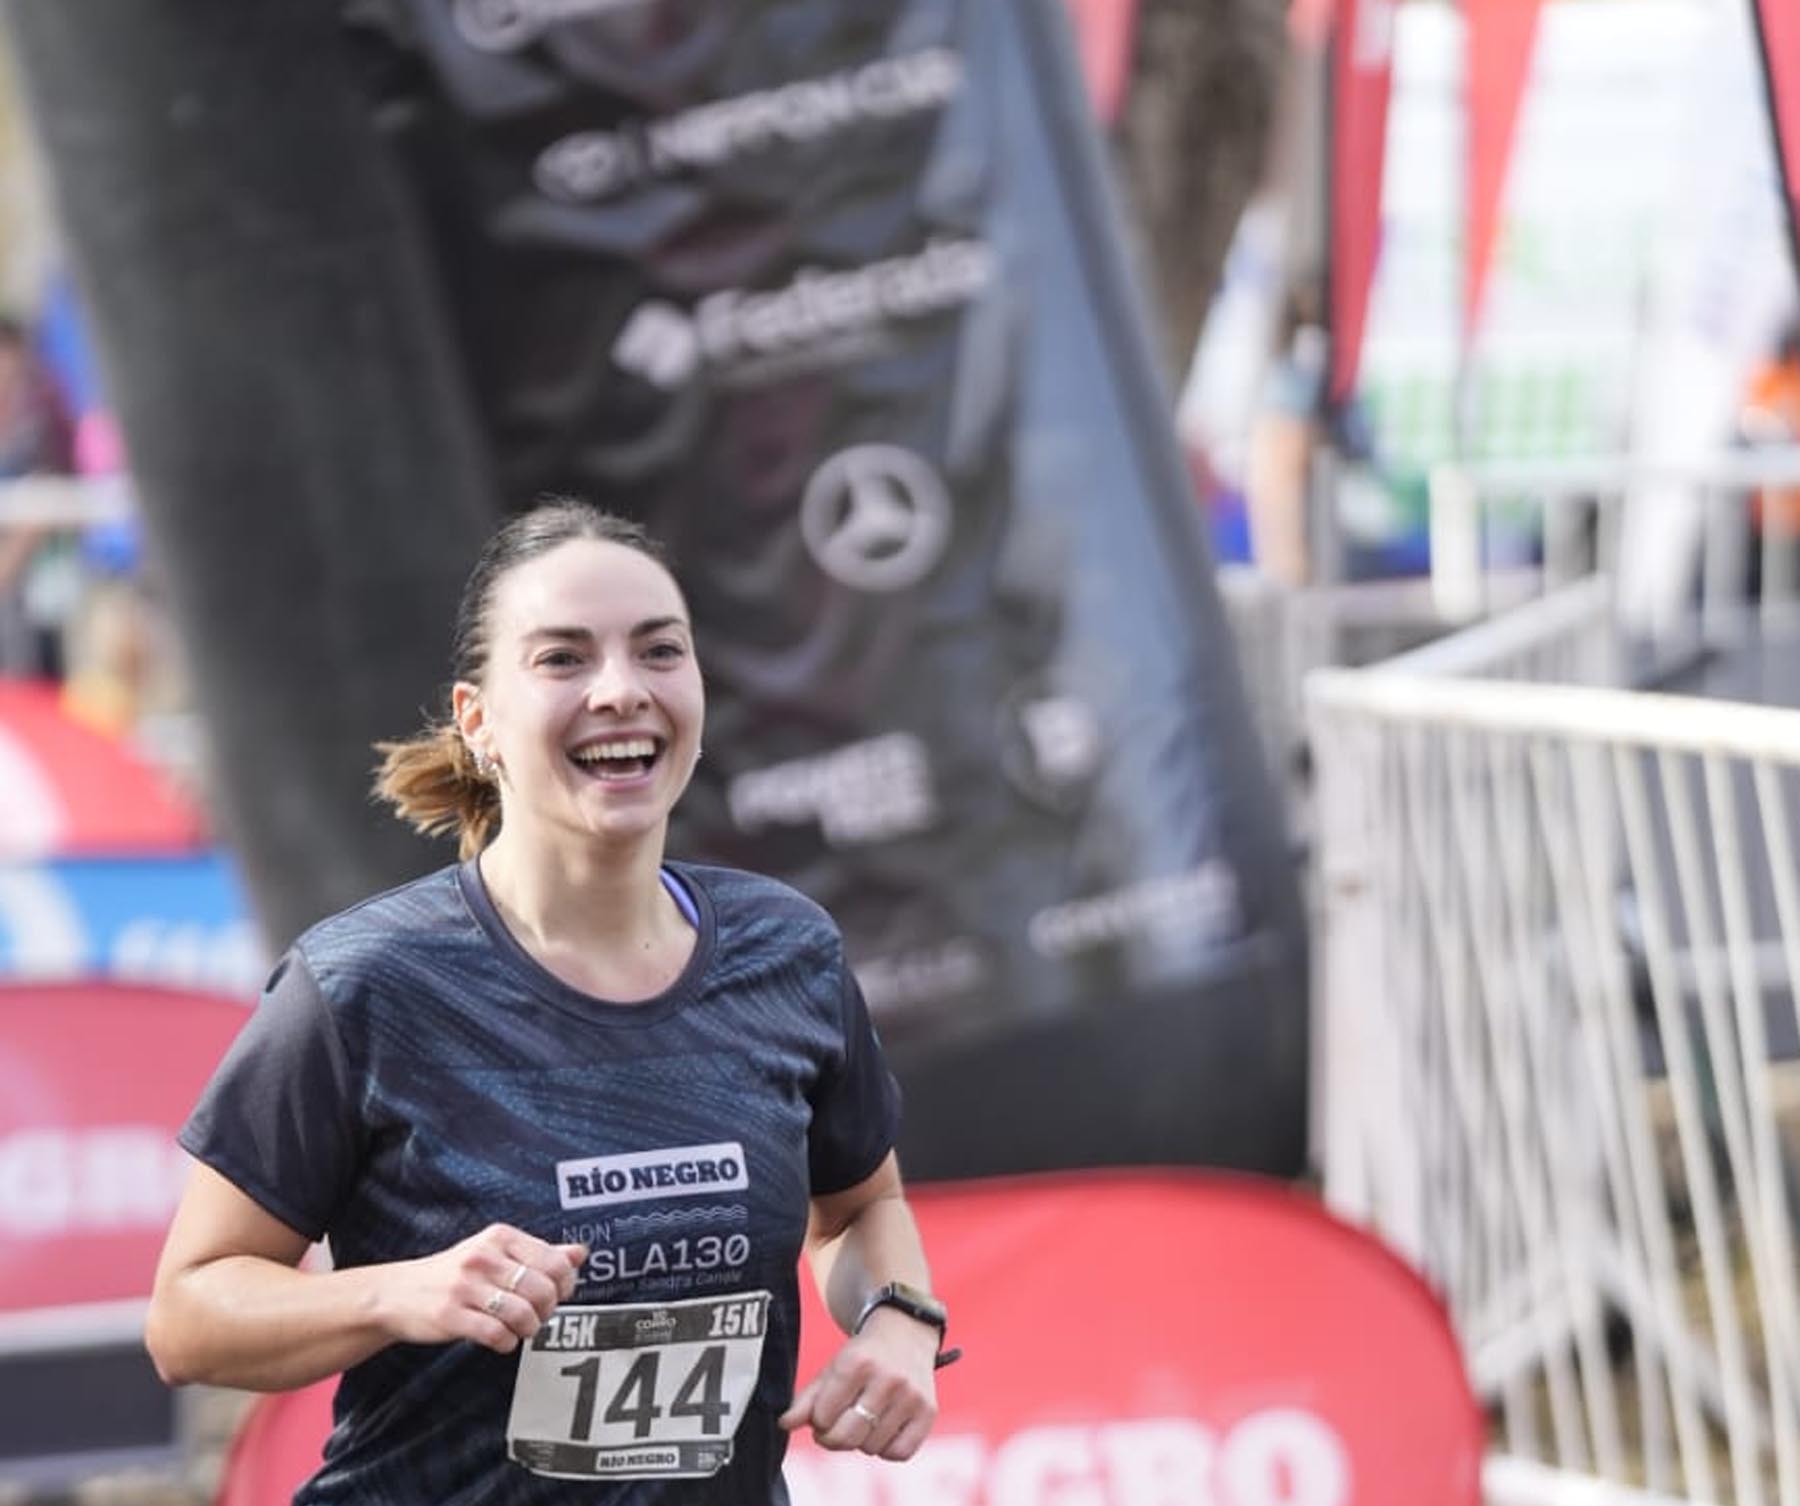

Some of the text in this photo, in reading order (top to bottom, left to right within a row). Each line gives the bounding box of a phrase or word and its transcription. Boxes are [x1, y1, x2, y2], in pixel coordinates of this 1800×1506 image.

[566, 1158, 739, 1198] RÍO NEGRO
[545, 1314, 599, 1348] 15K
[708, 1302, 760, 1337] 15K
[561, 1346, 730, 1441] 144
